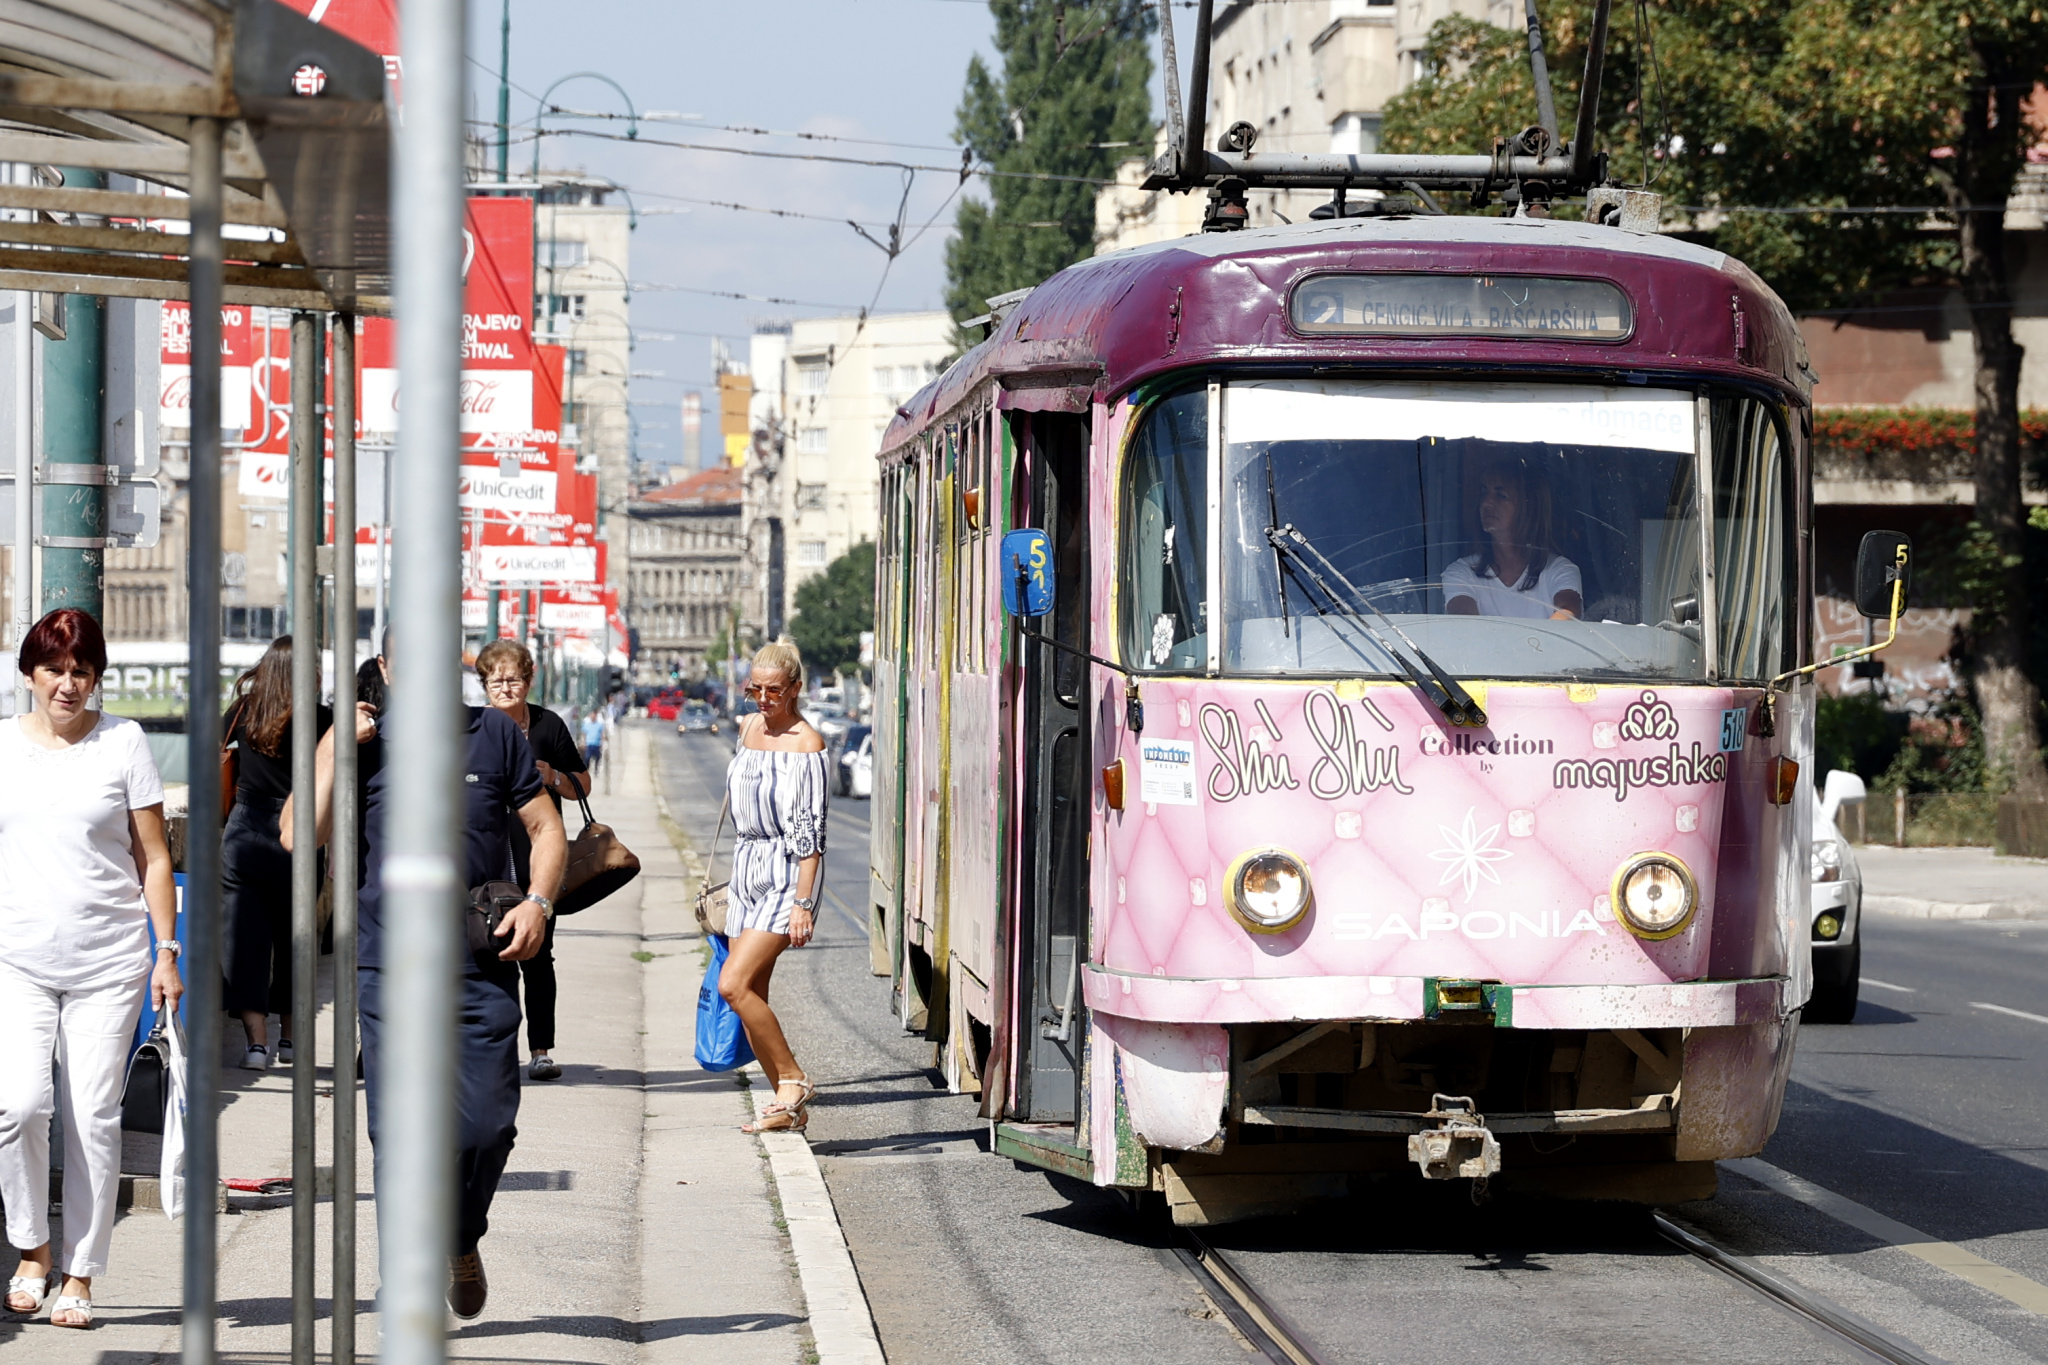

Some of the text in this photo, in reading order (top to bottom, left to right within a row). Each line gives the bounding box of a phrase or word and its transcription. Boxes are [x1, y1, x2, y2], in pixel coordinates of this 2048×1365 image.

[1309, 295, 1340, 324] 2
[462, 314, 522, 330] RAJEVO
[460, 343, 514, 359] STIVAL
[473, 480, 545, 500] UniCredit
[510, 558, 566, 571] UniCredit
[1722, 711, 1745, 749] 518
[1419, 732, 1554, 757] Collection
[1479, 760, 1494, 774] by
[1553, 741, 1726, 802] majushka
[1331, 909, 1608, 941] SAPONIA
